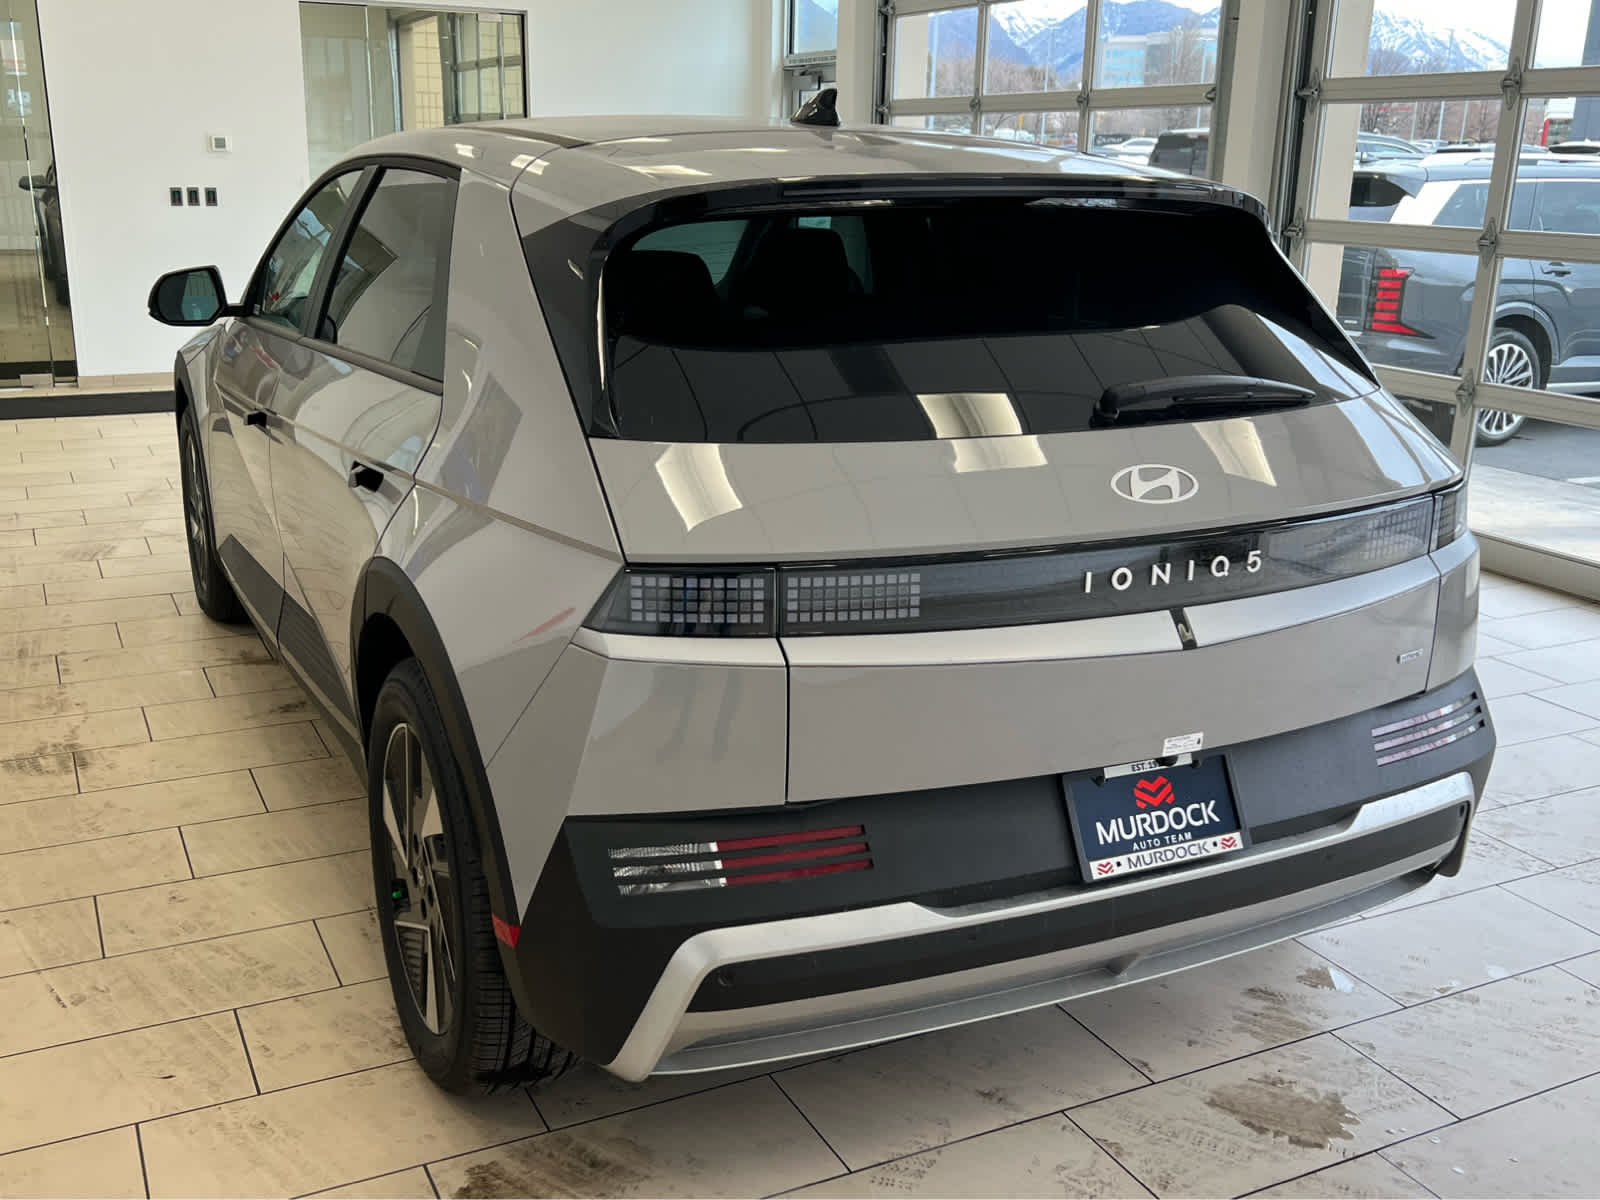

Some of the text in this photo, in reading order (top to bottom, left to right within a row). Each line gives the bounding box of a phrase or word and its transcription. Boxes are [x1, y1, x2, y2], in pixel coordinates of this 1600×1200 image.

[1084, 550, 1262, 593] IONIQ 5
[1095, 800, 1220, 845] MURDOCK
[1128, 842, 1210, 870] MURDOCK
[1133, 832, 1192, 851] AUTO TEAM
